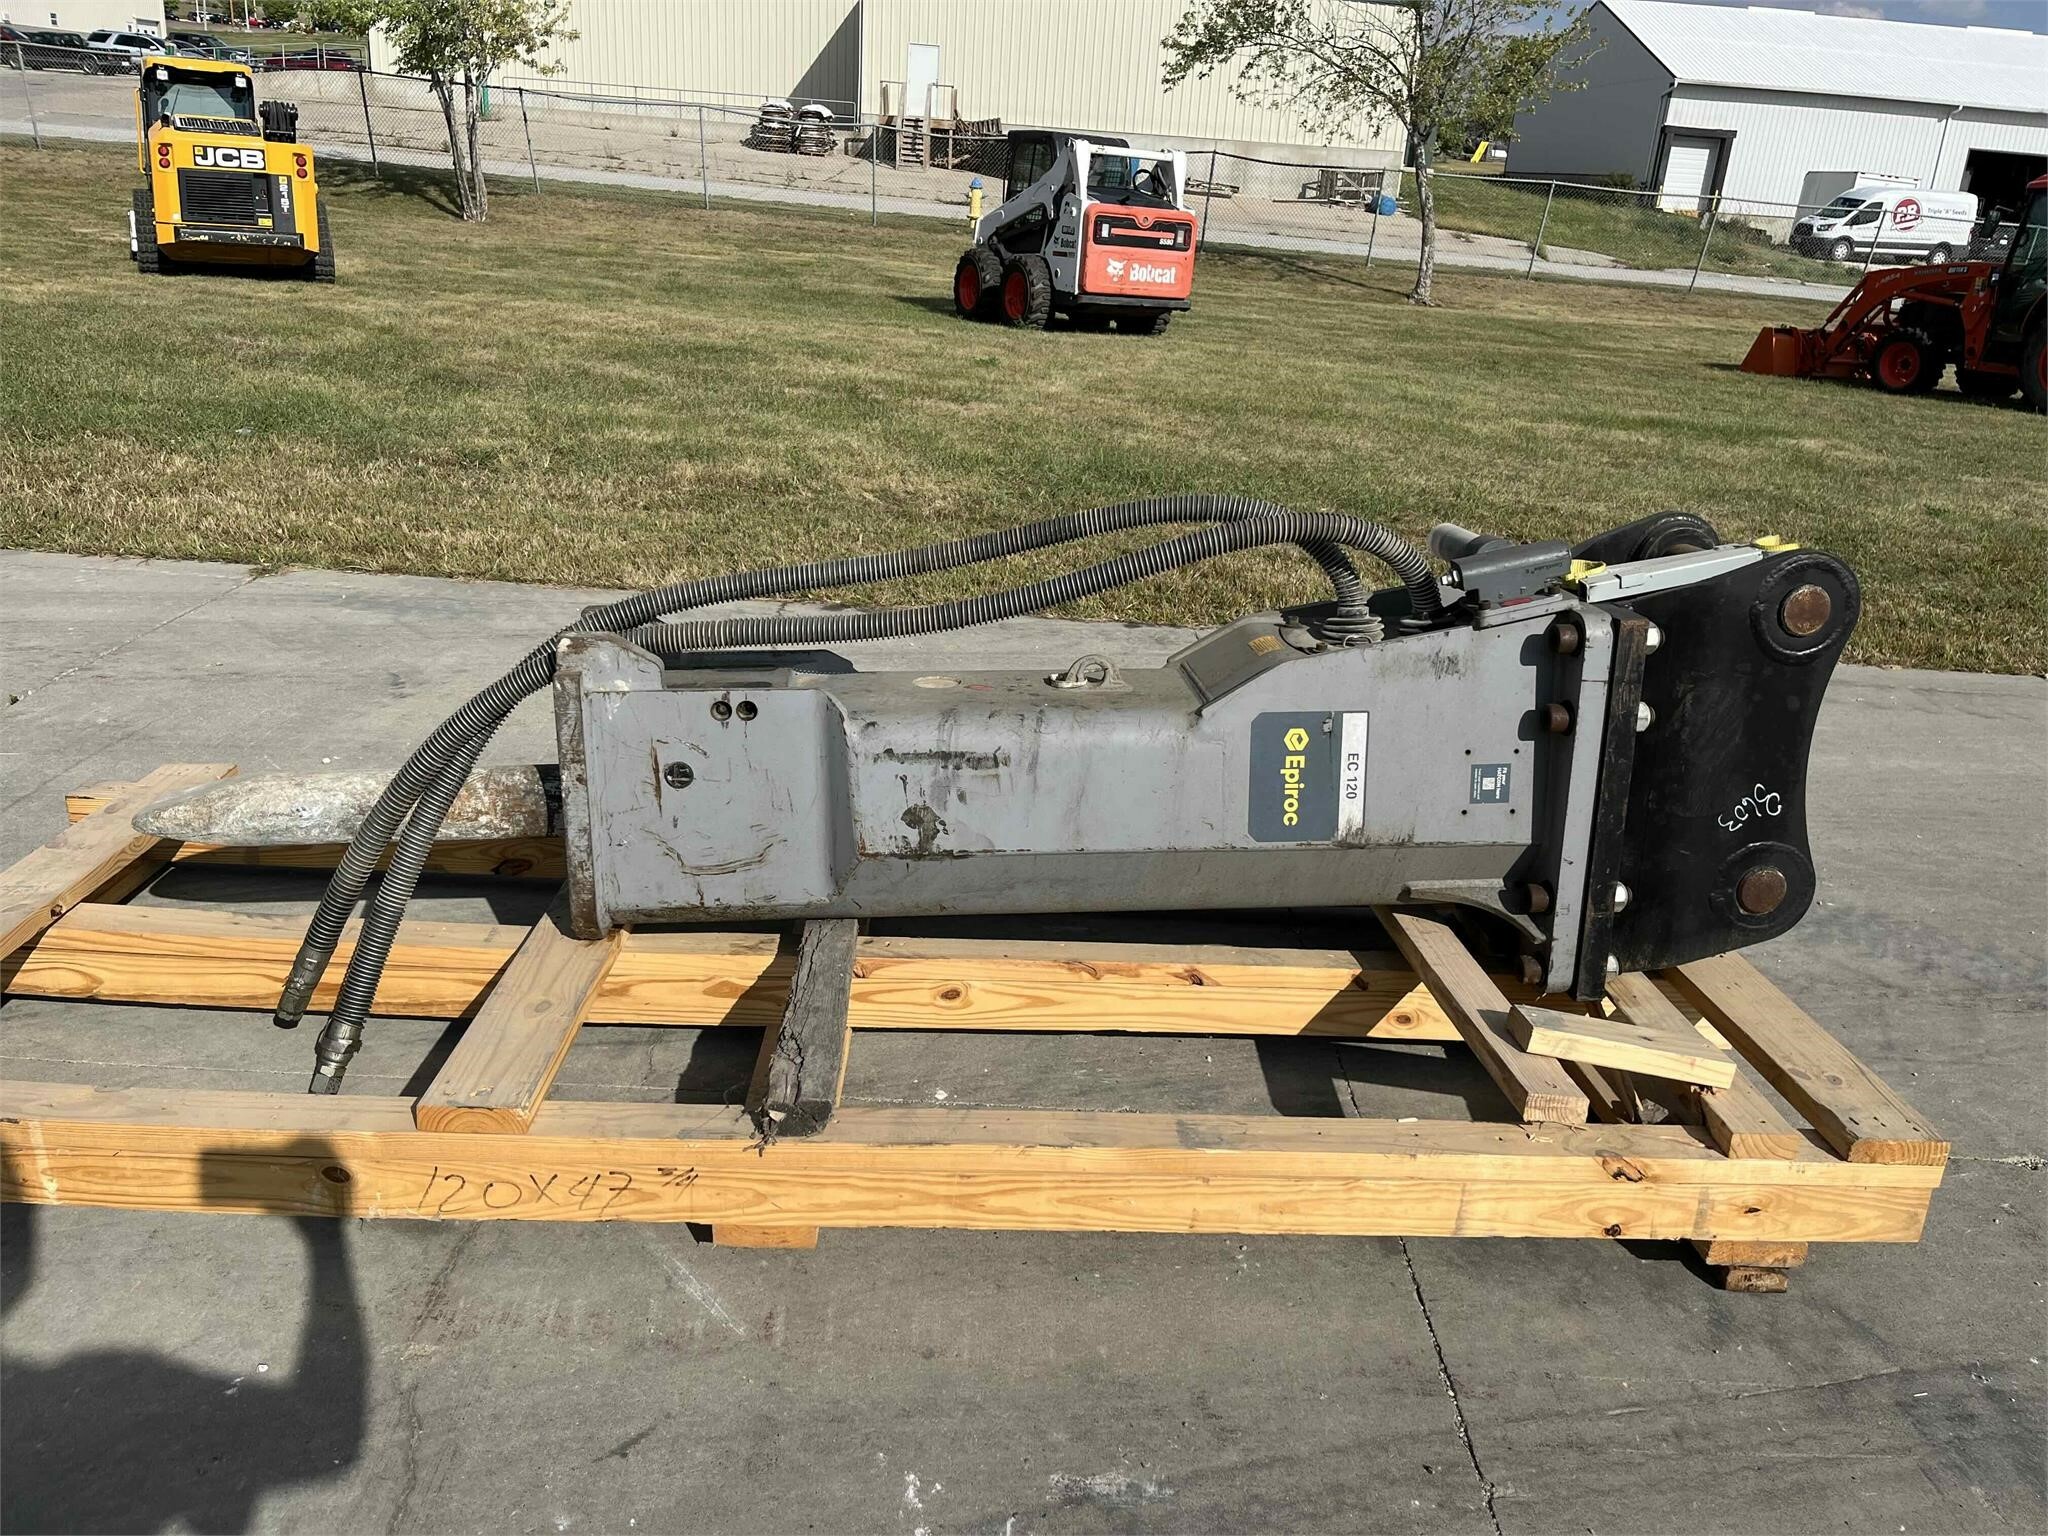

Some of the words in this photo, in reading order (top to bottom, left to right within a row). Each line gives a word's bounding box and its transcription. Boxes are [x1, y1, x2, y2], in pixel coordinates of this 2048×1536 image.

[195, 148, 264, 169] JCB
[1927, 207, 1943, 215] Triple
[1952, 208, 1967, 216] Seeds
[1060, 237, 1077, 249] Bobcat
[1129, 263, 1177, 285] Bobcat
[1347, 752, 1360, 771] EC
[1280, 755, 1305, 827] Epiroc
[1345, 777, 1359, 800] 120
